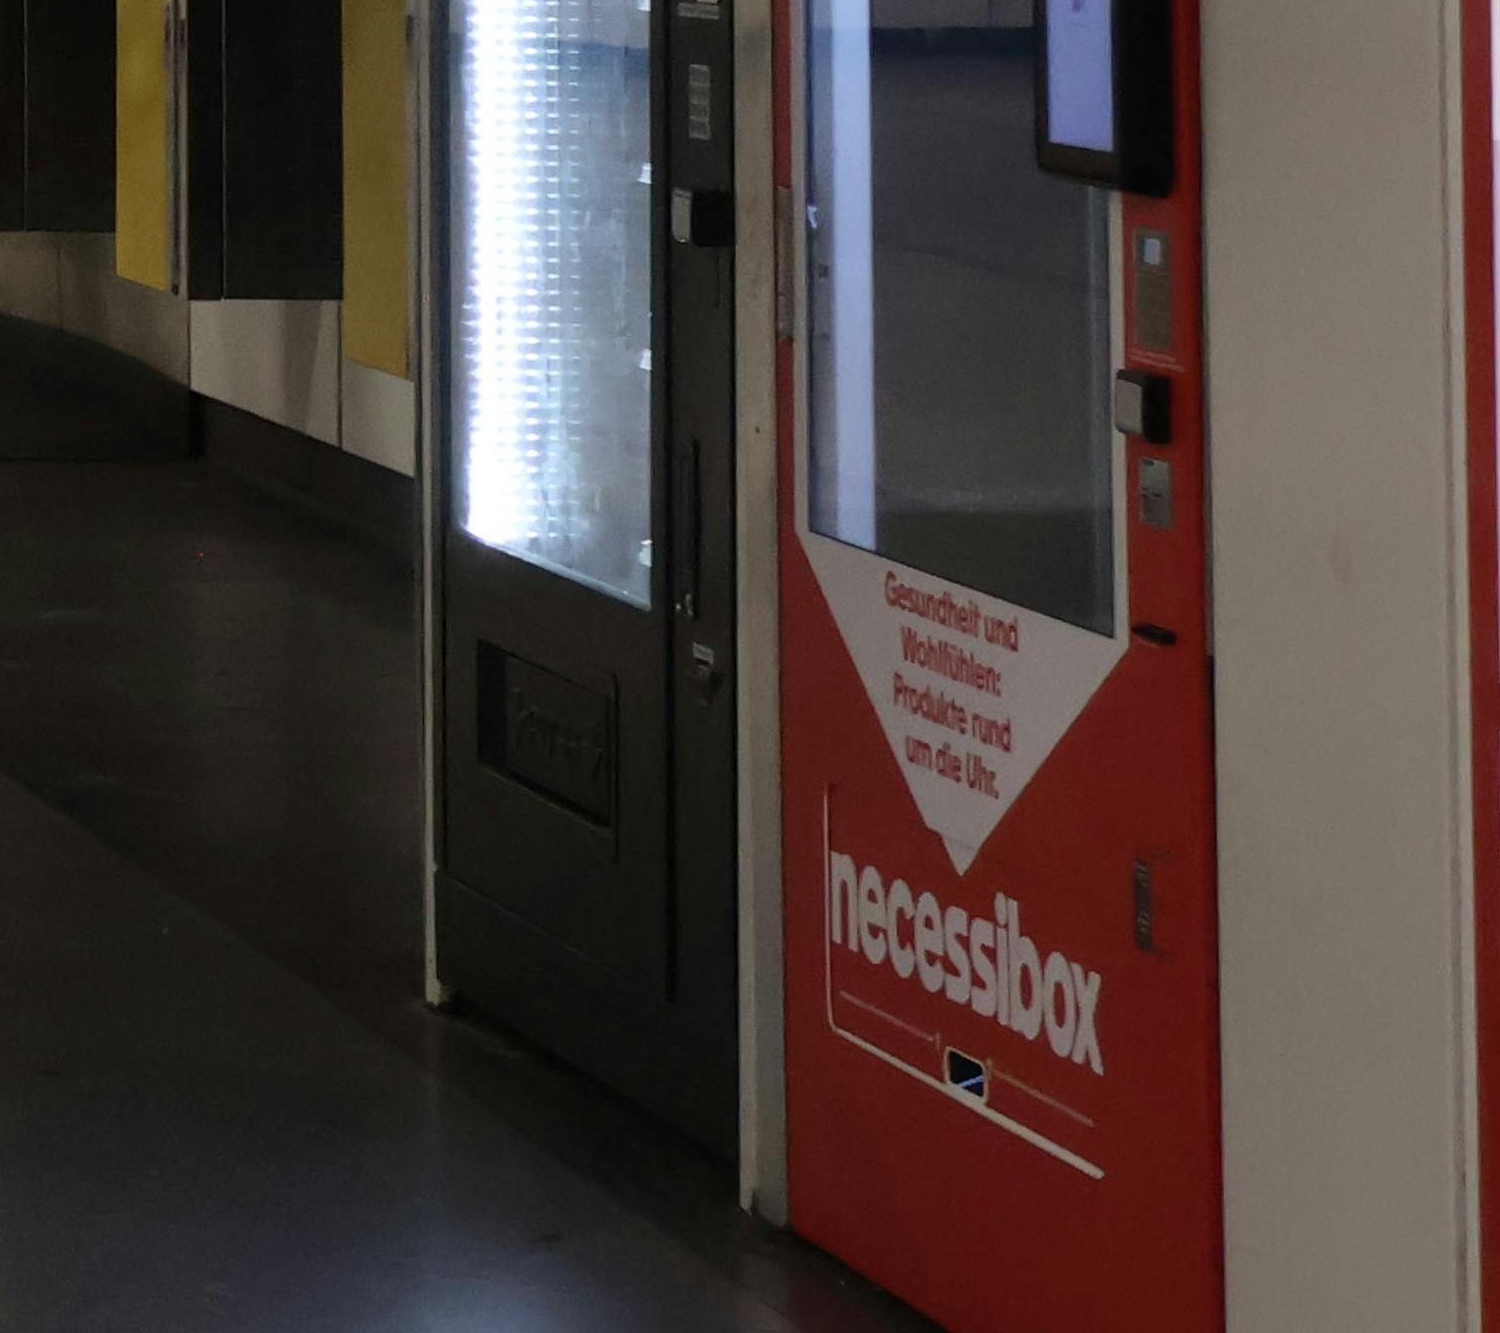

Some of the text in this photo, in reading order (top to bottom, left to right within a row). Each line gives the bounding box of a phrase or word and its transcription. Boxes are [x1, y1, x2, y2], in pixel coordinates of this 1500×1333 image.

[884, 570, 1019, 653] Gesundheit und
[900, 625, 1002, 698] Wohlfühlen:
[892, 671, 1012, 753] Produkte rund
[905, 734, 1000, 800] um die Uhr.
[831, 849, 1105, 1078] necessibox
